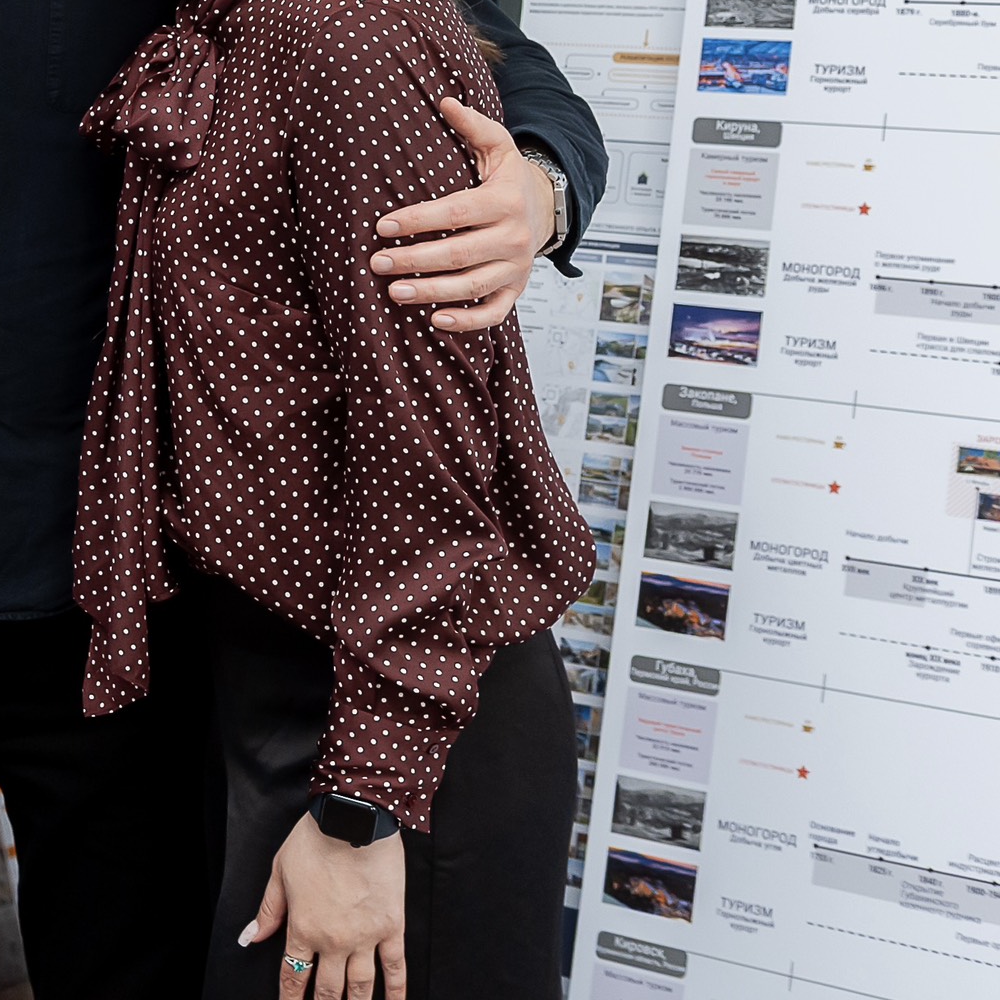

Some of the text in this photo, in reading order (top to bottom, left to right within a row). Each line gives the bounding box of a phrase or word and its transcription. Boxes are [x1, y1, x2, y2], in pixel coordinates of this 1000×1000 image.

[814, 64, 866, 76] ТУРИЗМ
[782, 262, 860, 279] МОНОГОРОД
[785, 335, 837, 350] ТУРИЗМ
[750, 540, 829, 563] МОНОГОРОД
[753, 612, 806, 631] ТУРИЗМ
[718, 820, 797, 848] МОНОГОРОД
[720, 896, 773, 918] ТУРИЗМ
